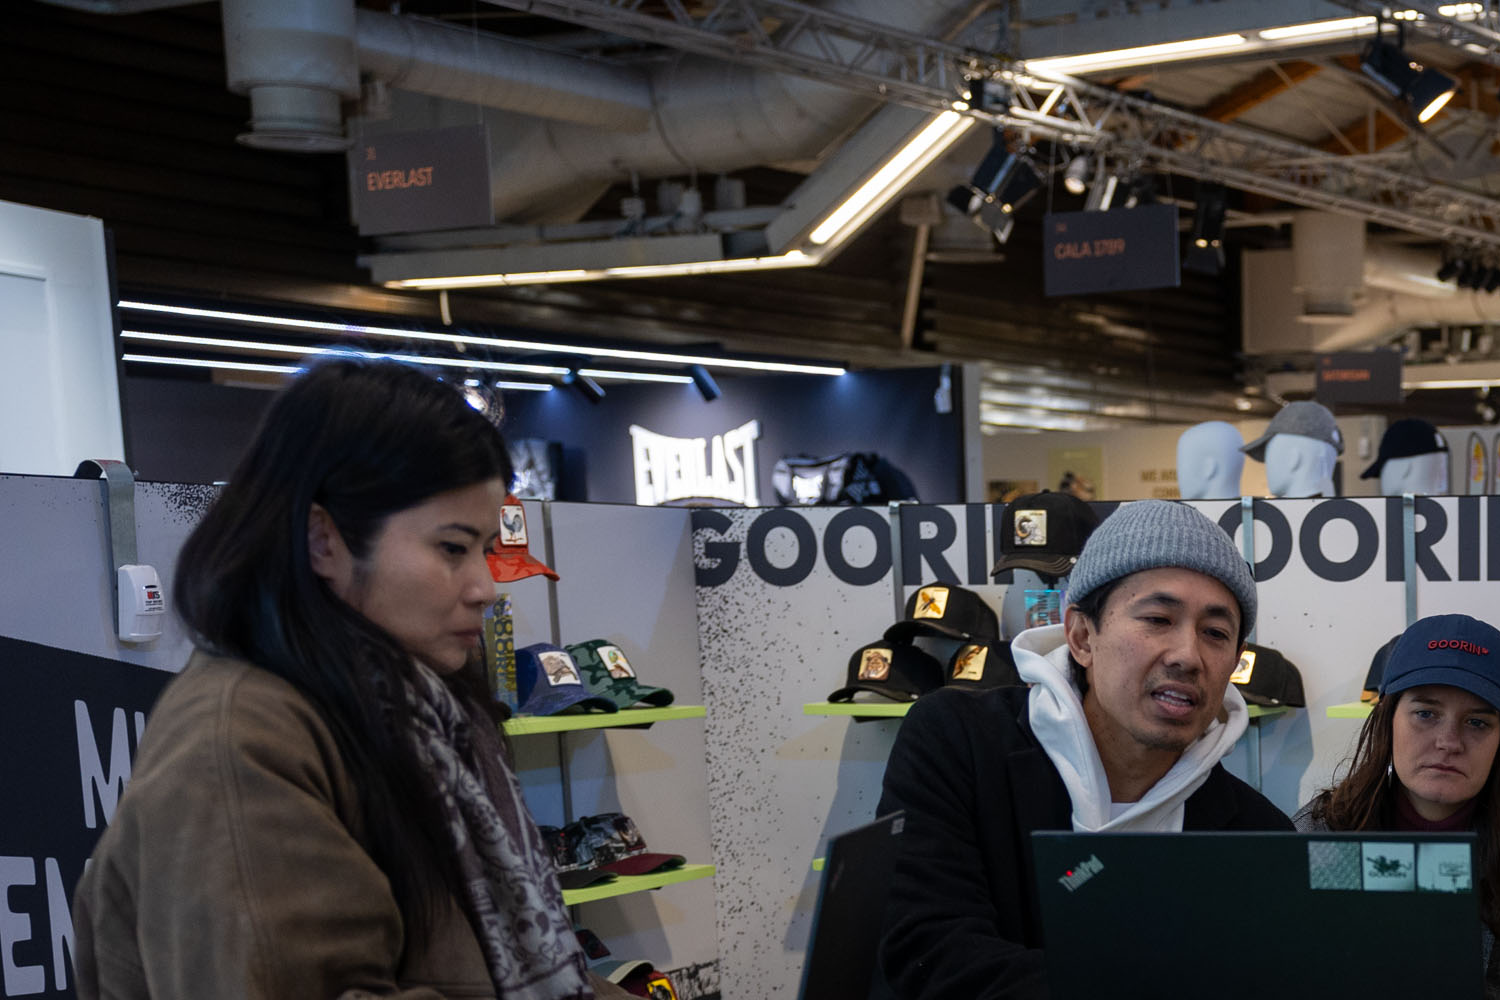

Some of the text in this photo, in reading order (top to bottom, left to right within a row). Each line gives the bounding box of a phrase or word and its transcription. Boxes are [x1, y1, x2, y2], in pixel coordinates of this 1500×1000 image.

[367, 167, 433, 191] EVERLAST
[1054, 239, 1092, 260] CALA
[629, 419, 762, 507] EVERLAST
[1428, 640, 1481, 656] GOORIN
[75, 700, 146, 829] M
[1058, 854, 1104, 892] ThinkPad
